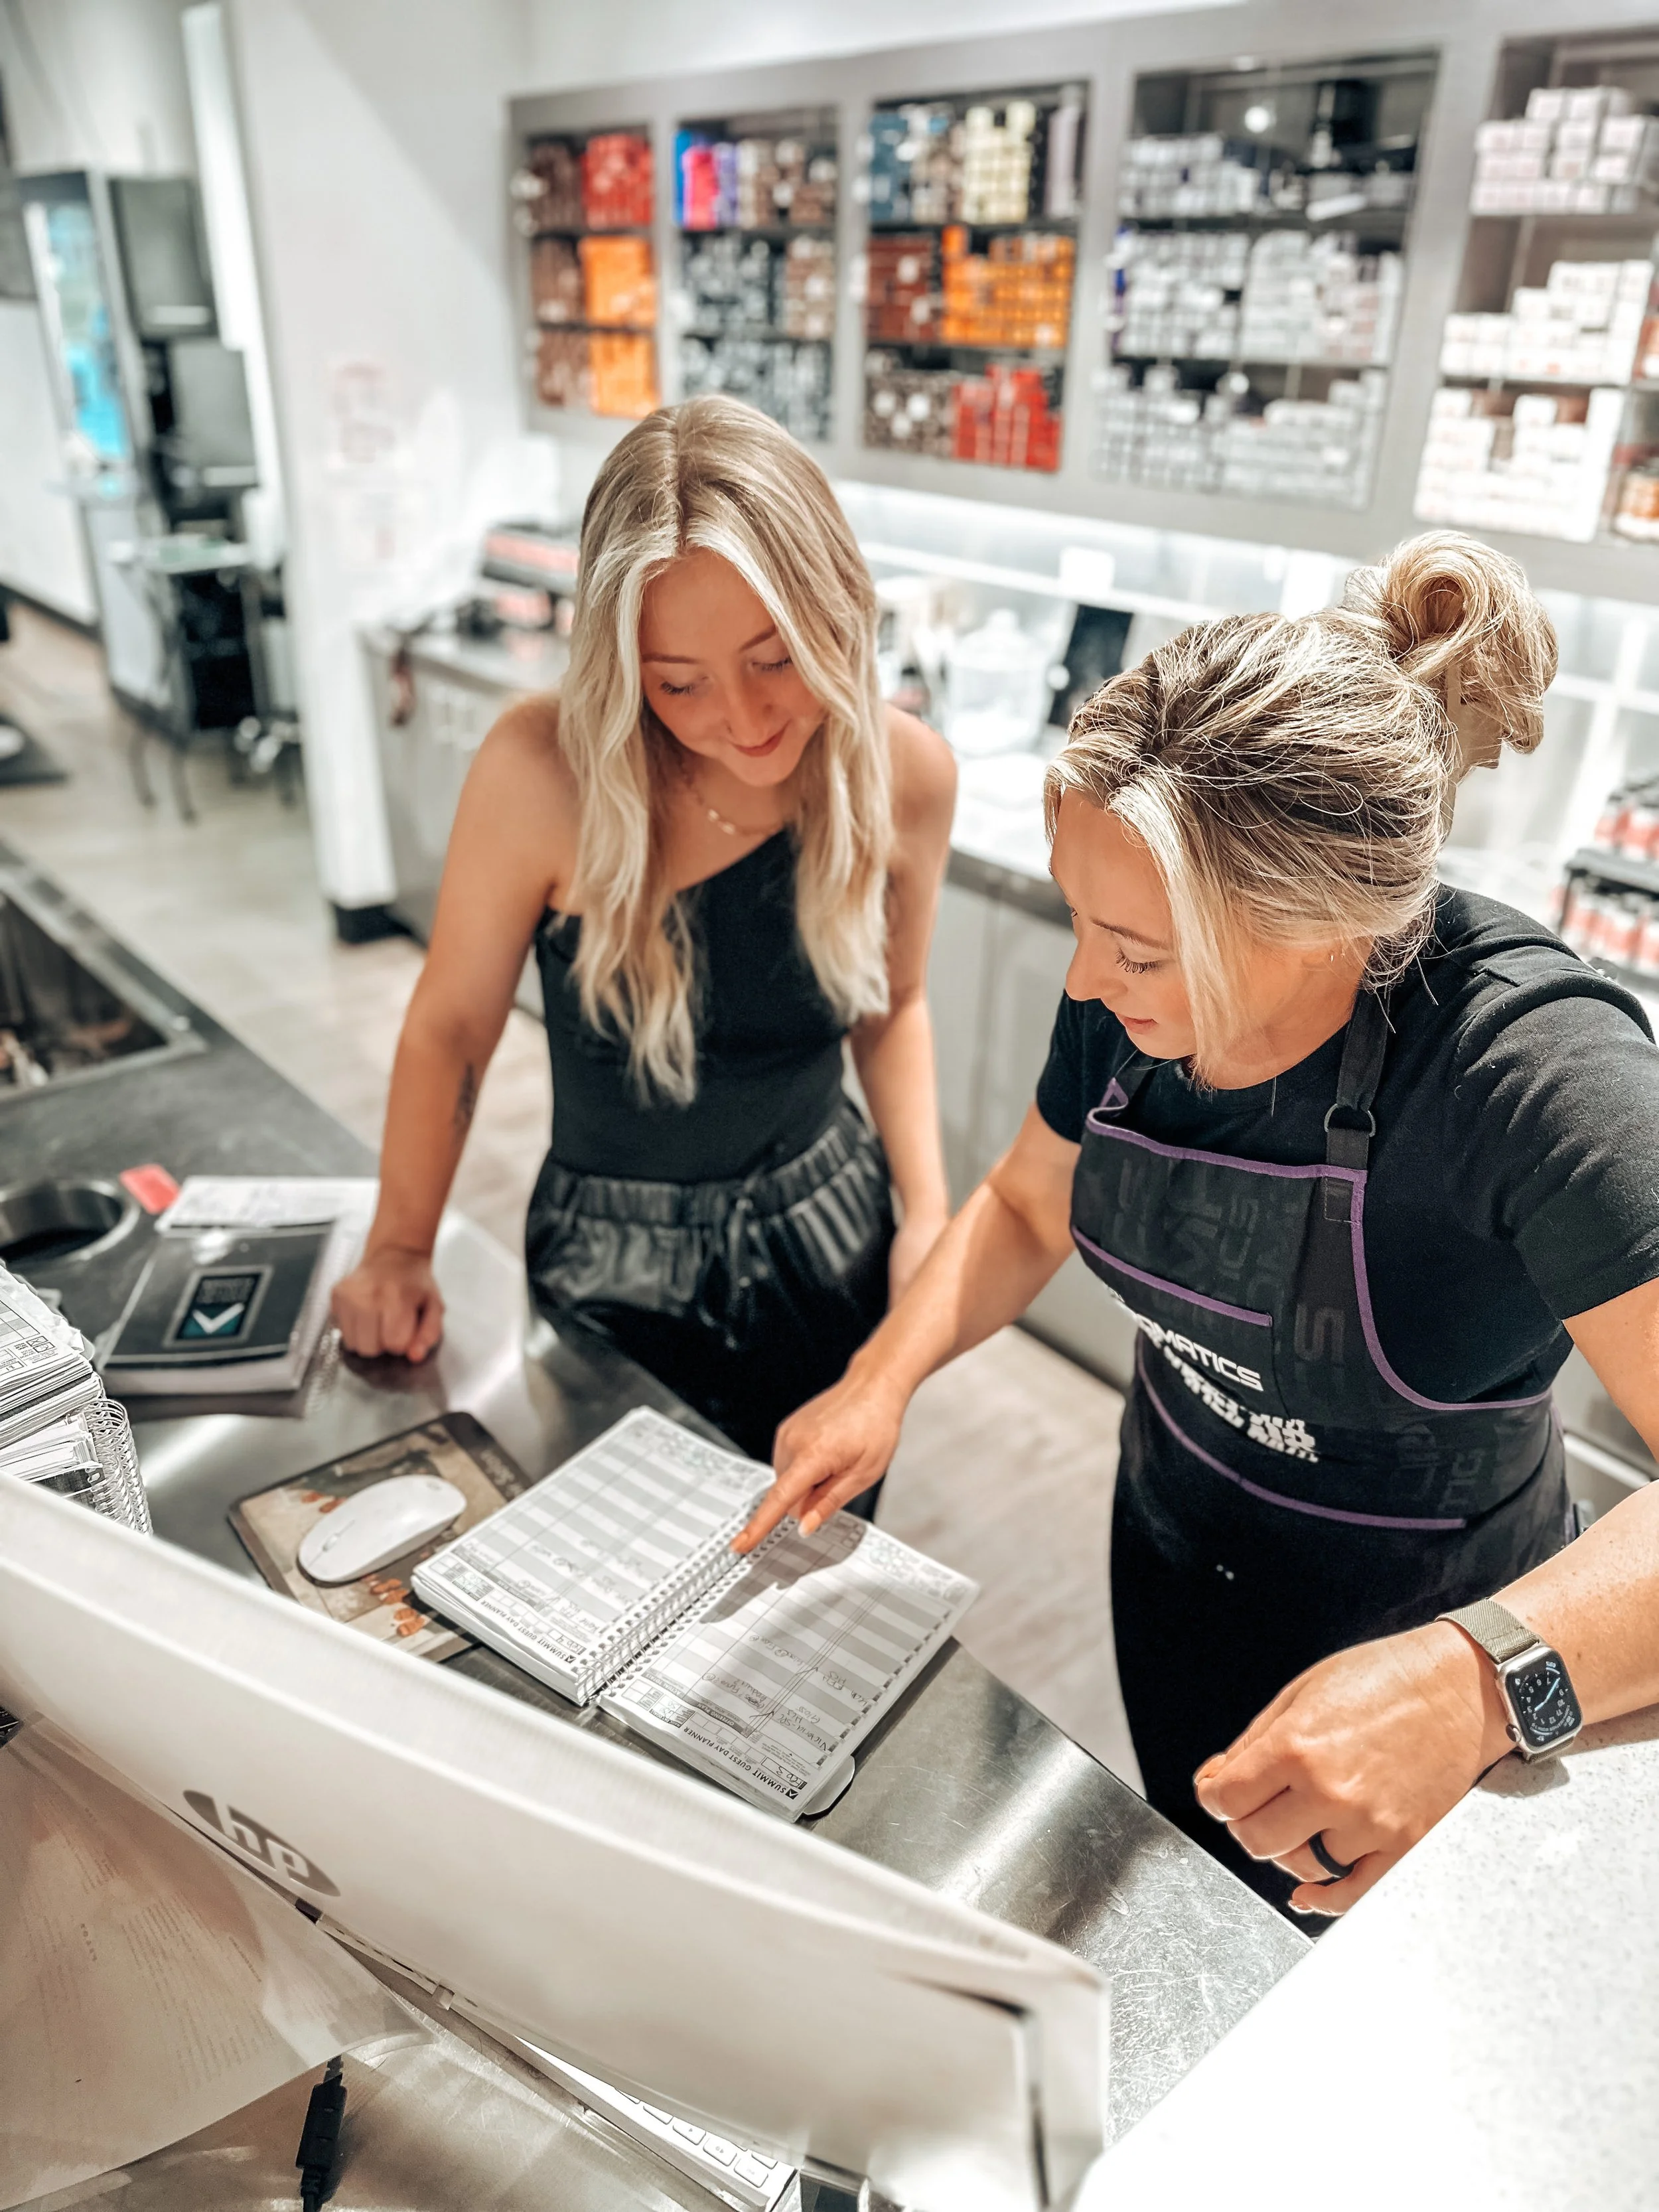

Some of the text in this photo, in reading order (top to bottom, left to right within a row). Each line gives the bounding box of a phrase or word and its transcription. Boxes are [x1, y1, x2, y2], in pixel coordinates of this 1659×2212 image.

[480, 1599, 566, 1659] SUMMIT GUEST DAY PLANNER
[556, 1633, 565, 1643] 4
[697, 1702, 735, 1726] OFFERING PLAN
[682, 1726, 715, 1747] PLANNER
[713, 1744, 729, 1756] DAY
[728, 1753, 752, 1771] GUEST
[775, 1765, 786, 1777] 3
[751, 1769, 786, 1794] SUMMIT
[207, 1791, 312, 1883] hp
